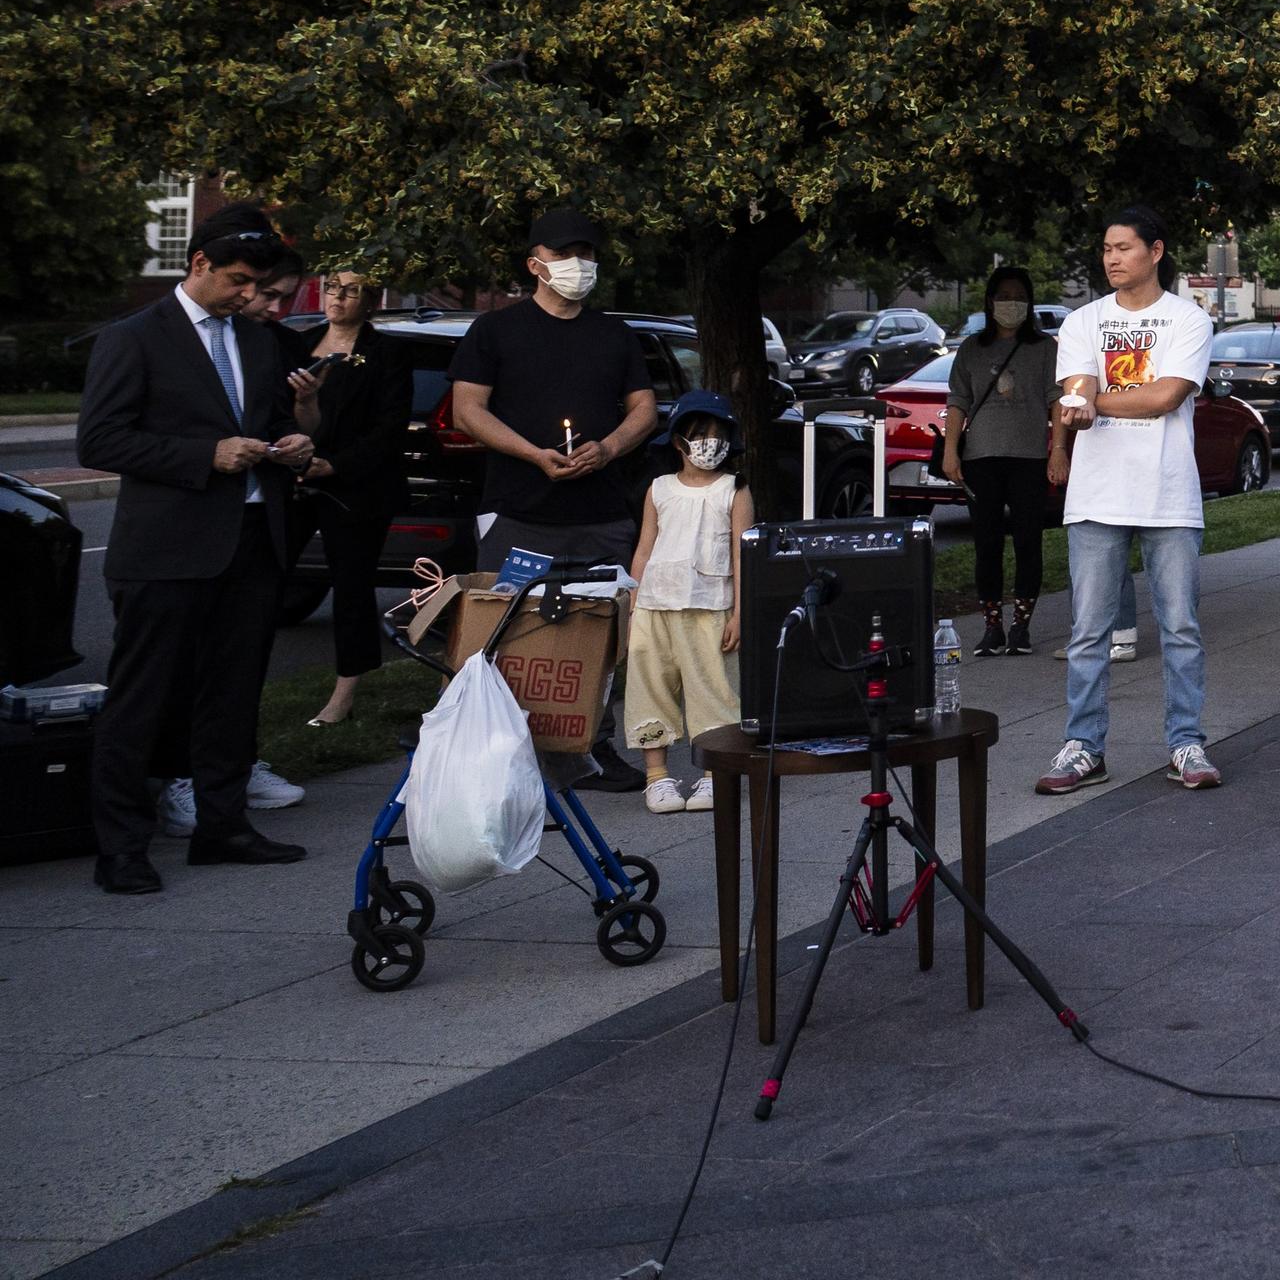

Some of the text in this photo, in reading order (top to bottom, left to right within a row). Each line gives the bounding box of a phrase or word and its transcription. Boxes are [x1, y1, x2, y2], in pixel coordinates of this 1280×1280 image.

[1101, 330, 1157, 352] END
[501, 655, 584, 703] GGS
[529, 712, 586, 737] GERATED
